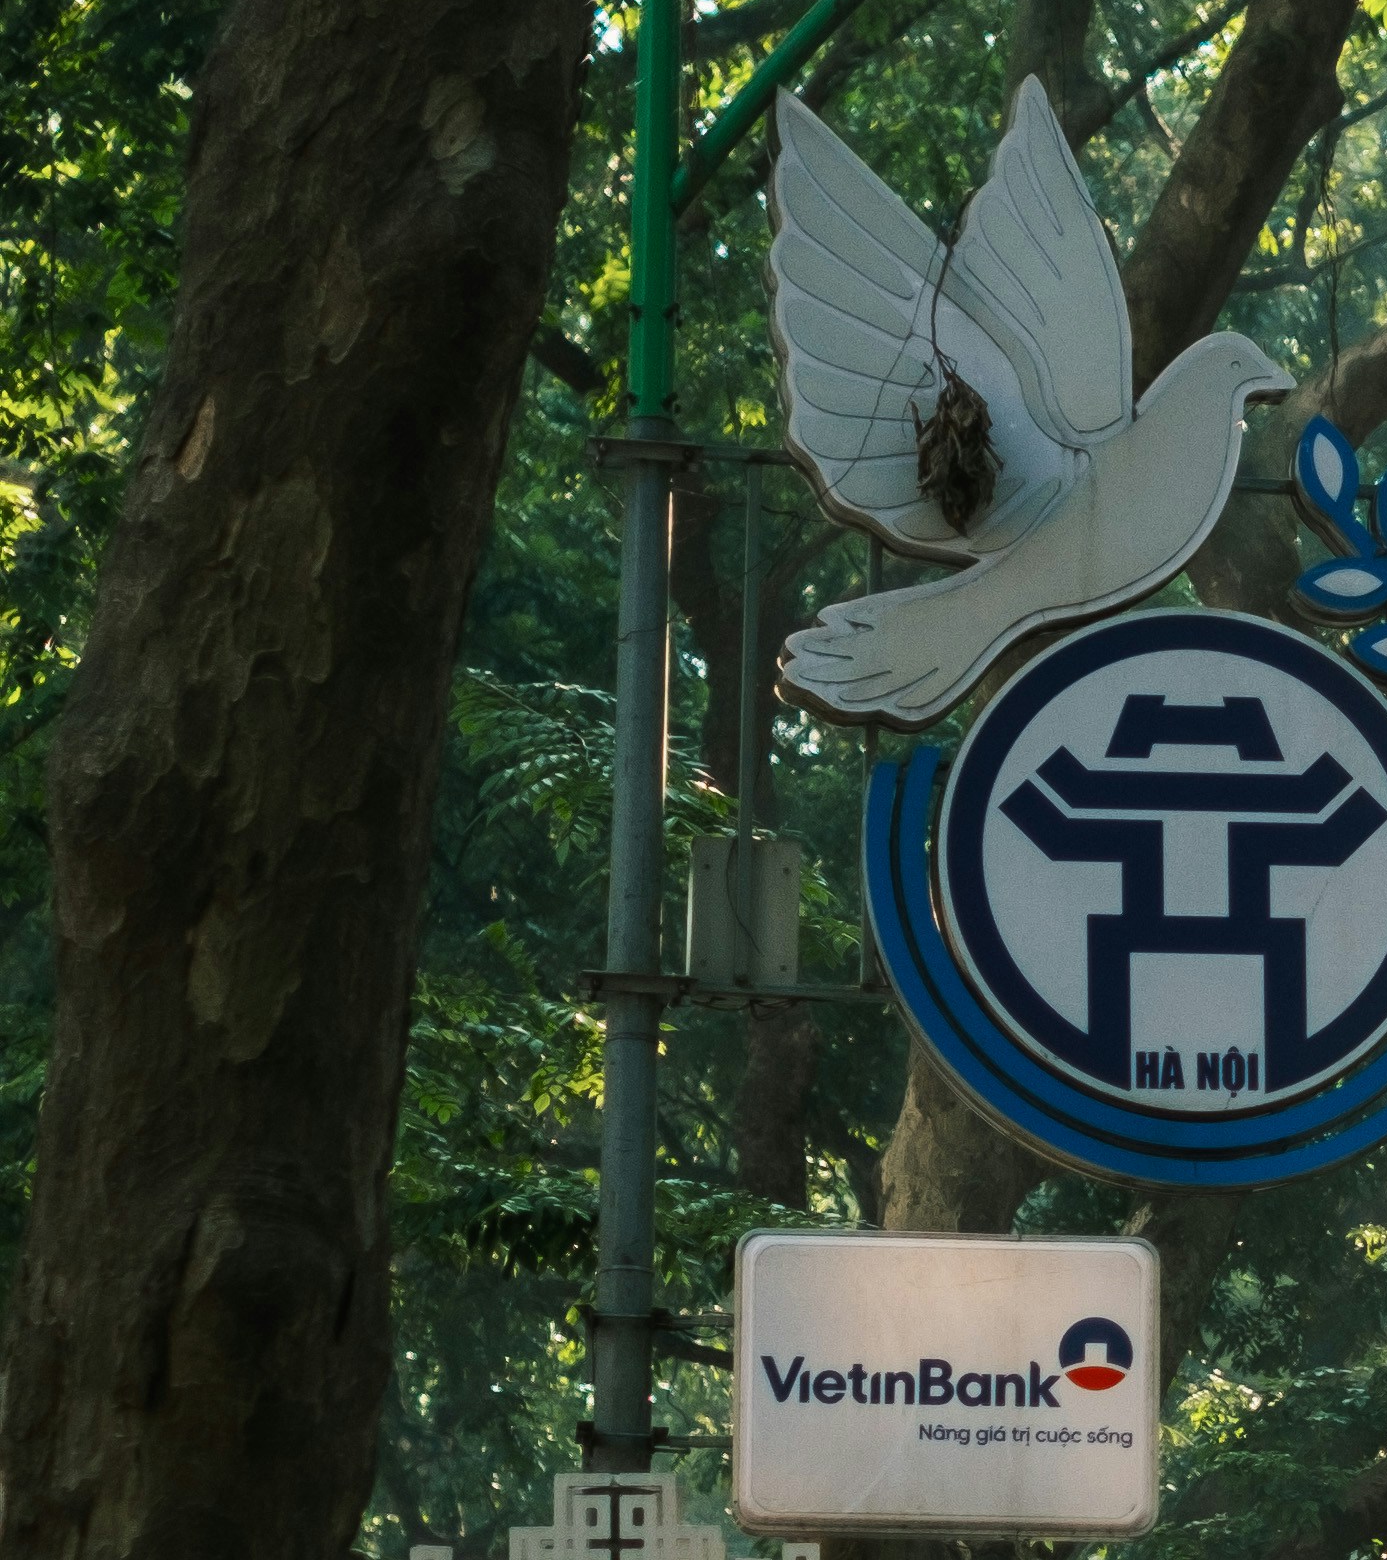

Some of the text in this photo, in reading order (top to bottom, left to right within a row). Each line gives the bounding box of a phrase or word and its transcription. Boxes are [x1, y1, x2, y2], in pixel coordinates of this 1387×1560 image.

[1136, 1046, 1259, 1098] HÀ NỘI
[760, 1355, 1061, 1408] VietinBank
[918, 1424, 1134, 1449] Nâng giá trị cuộc sống
